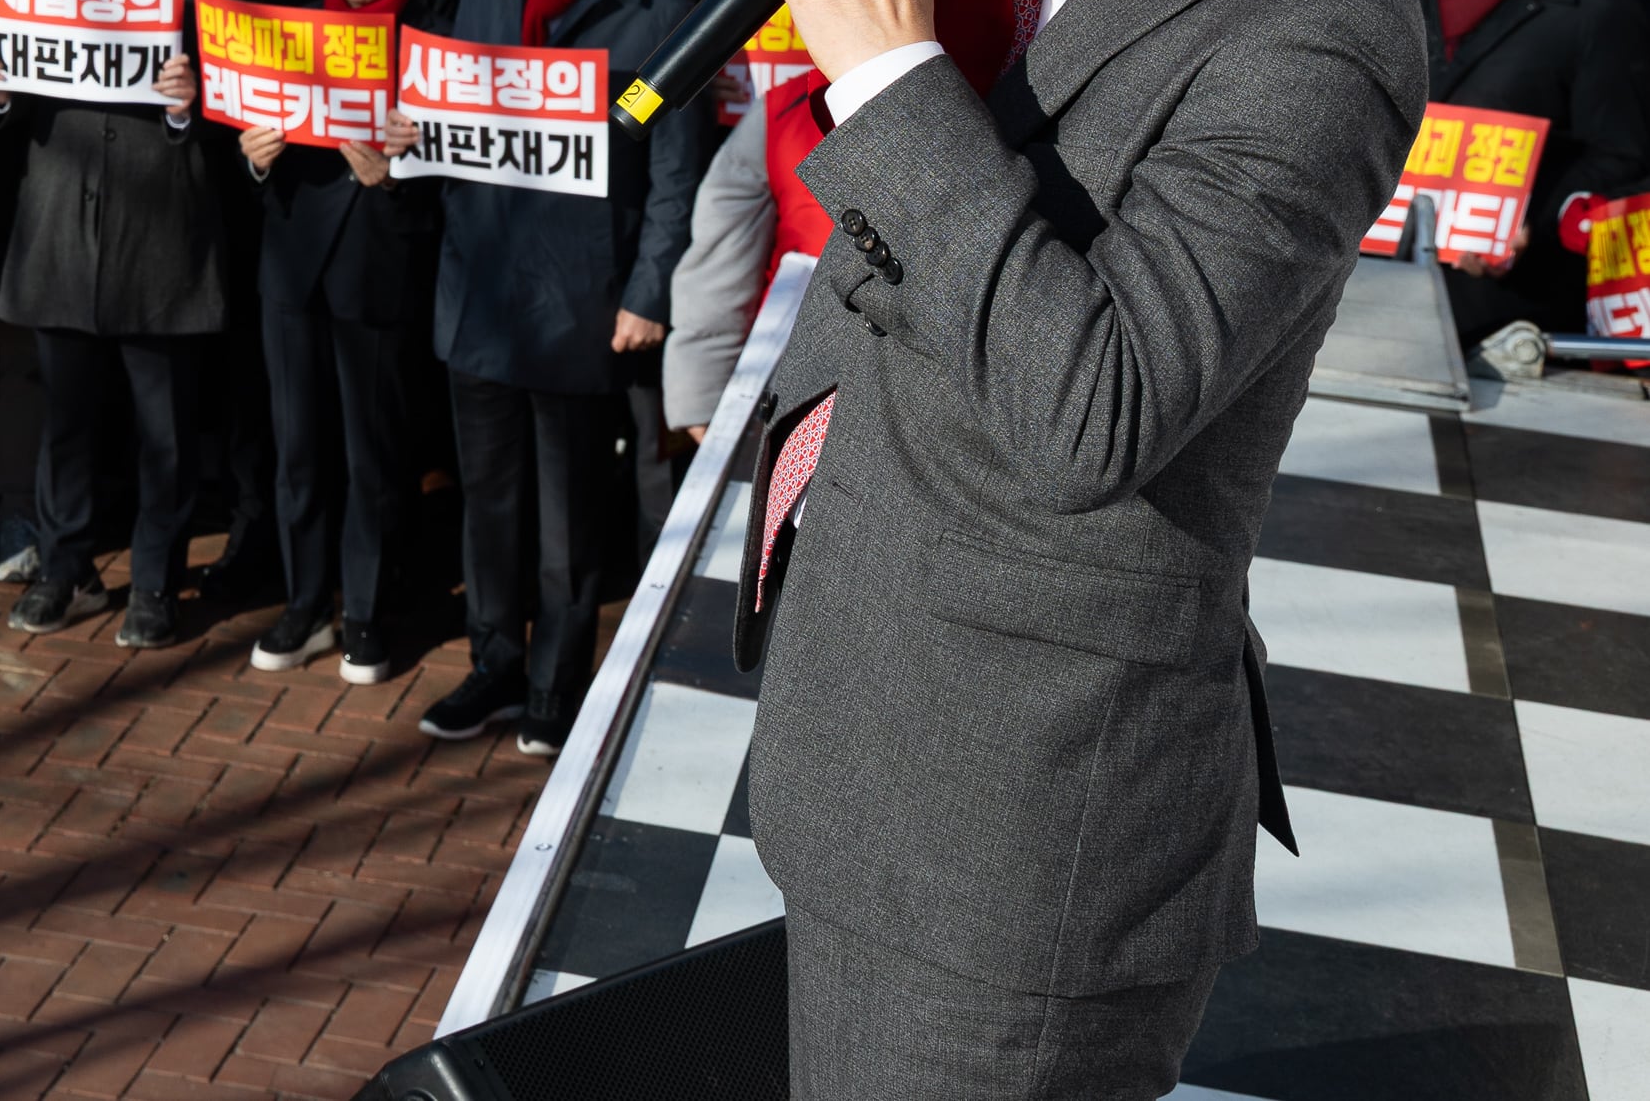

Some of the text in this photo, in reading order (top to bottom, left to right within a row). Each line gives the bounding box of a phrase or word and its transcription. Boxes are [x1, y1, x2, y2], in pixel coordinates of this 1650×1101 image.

[200, 2, 388, 80] 민생파괴 정권
[203, 61, 388, 141] 레드카드!
[400, 43, 595, 114] 사법정의
[1464, 122, 1538, 188] 정권
